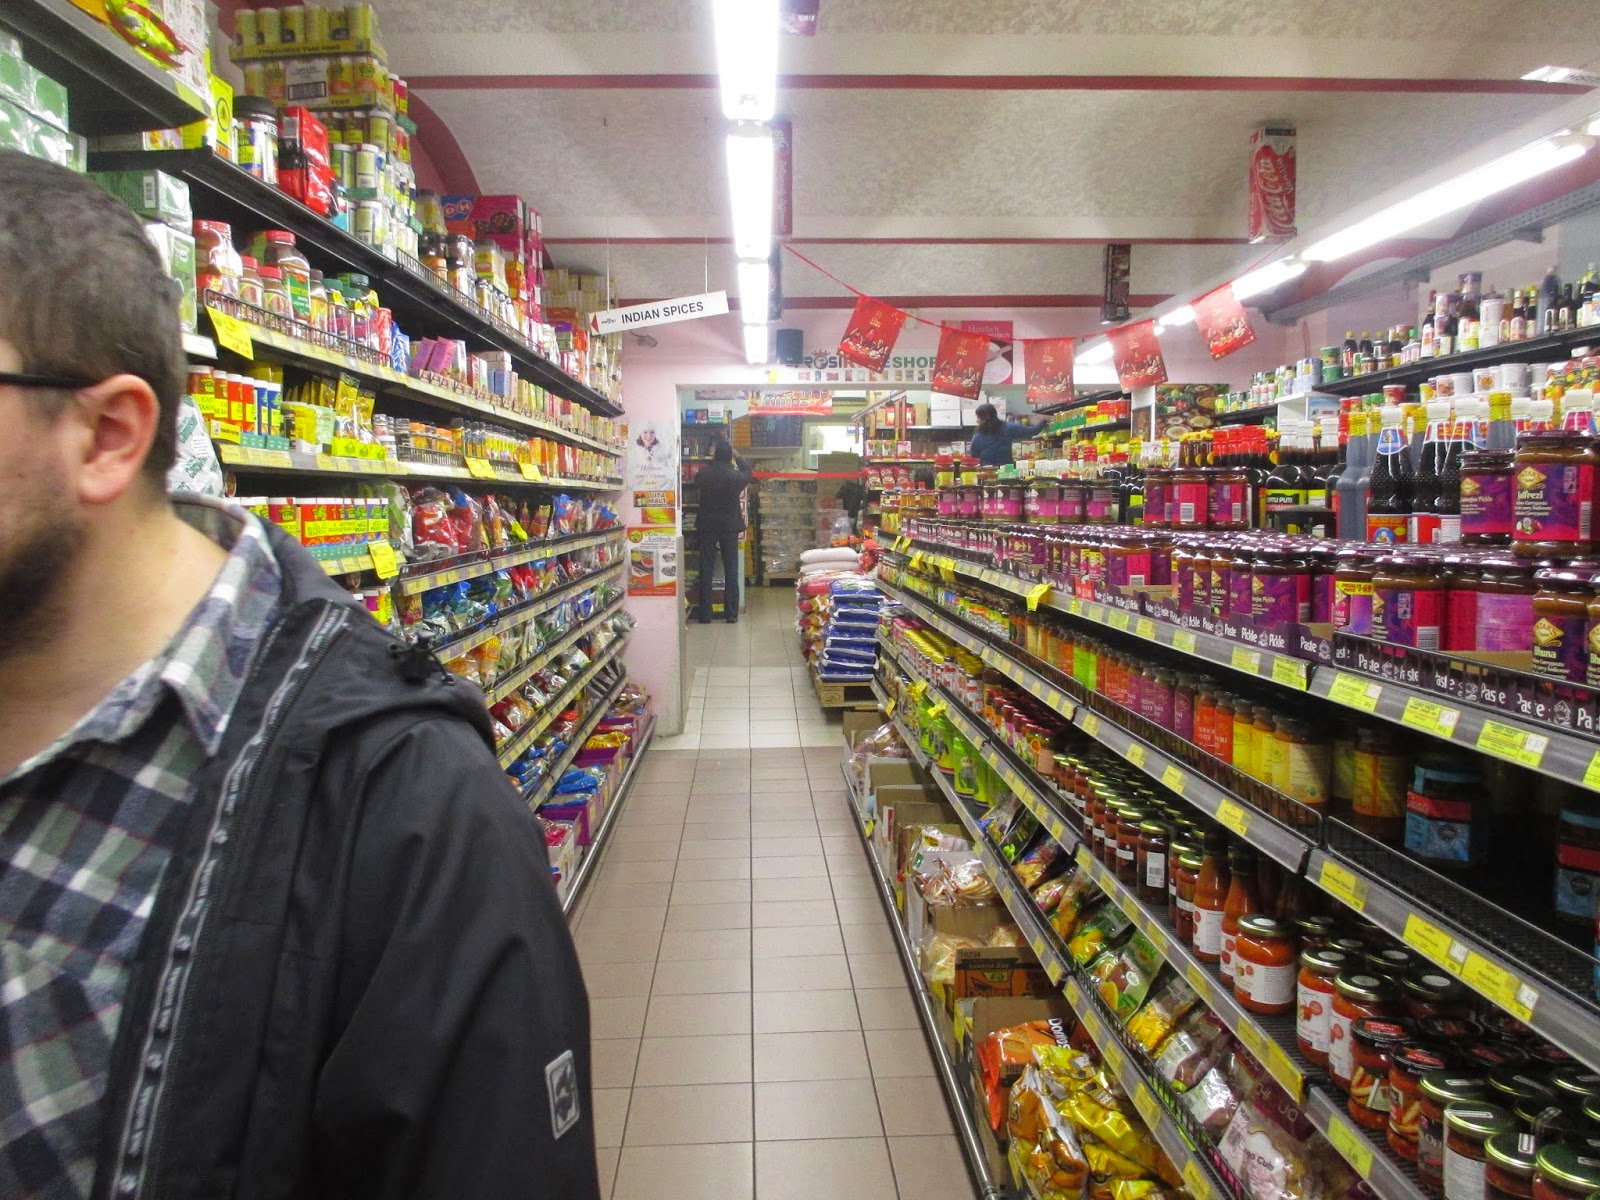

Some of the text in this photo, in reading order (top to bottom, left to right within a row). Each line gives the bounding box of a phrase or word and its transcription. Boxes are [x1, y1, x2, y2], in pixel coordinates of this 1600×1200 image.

[621, 309, 660, 324] INDIAN
[663, 301, 704, 317] SPICES
[1269, 633, 1285, 649] Pickle
[1300, 636, 1317, 652] Paste
